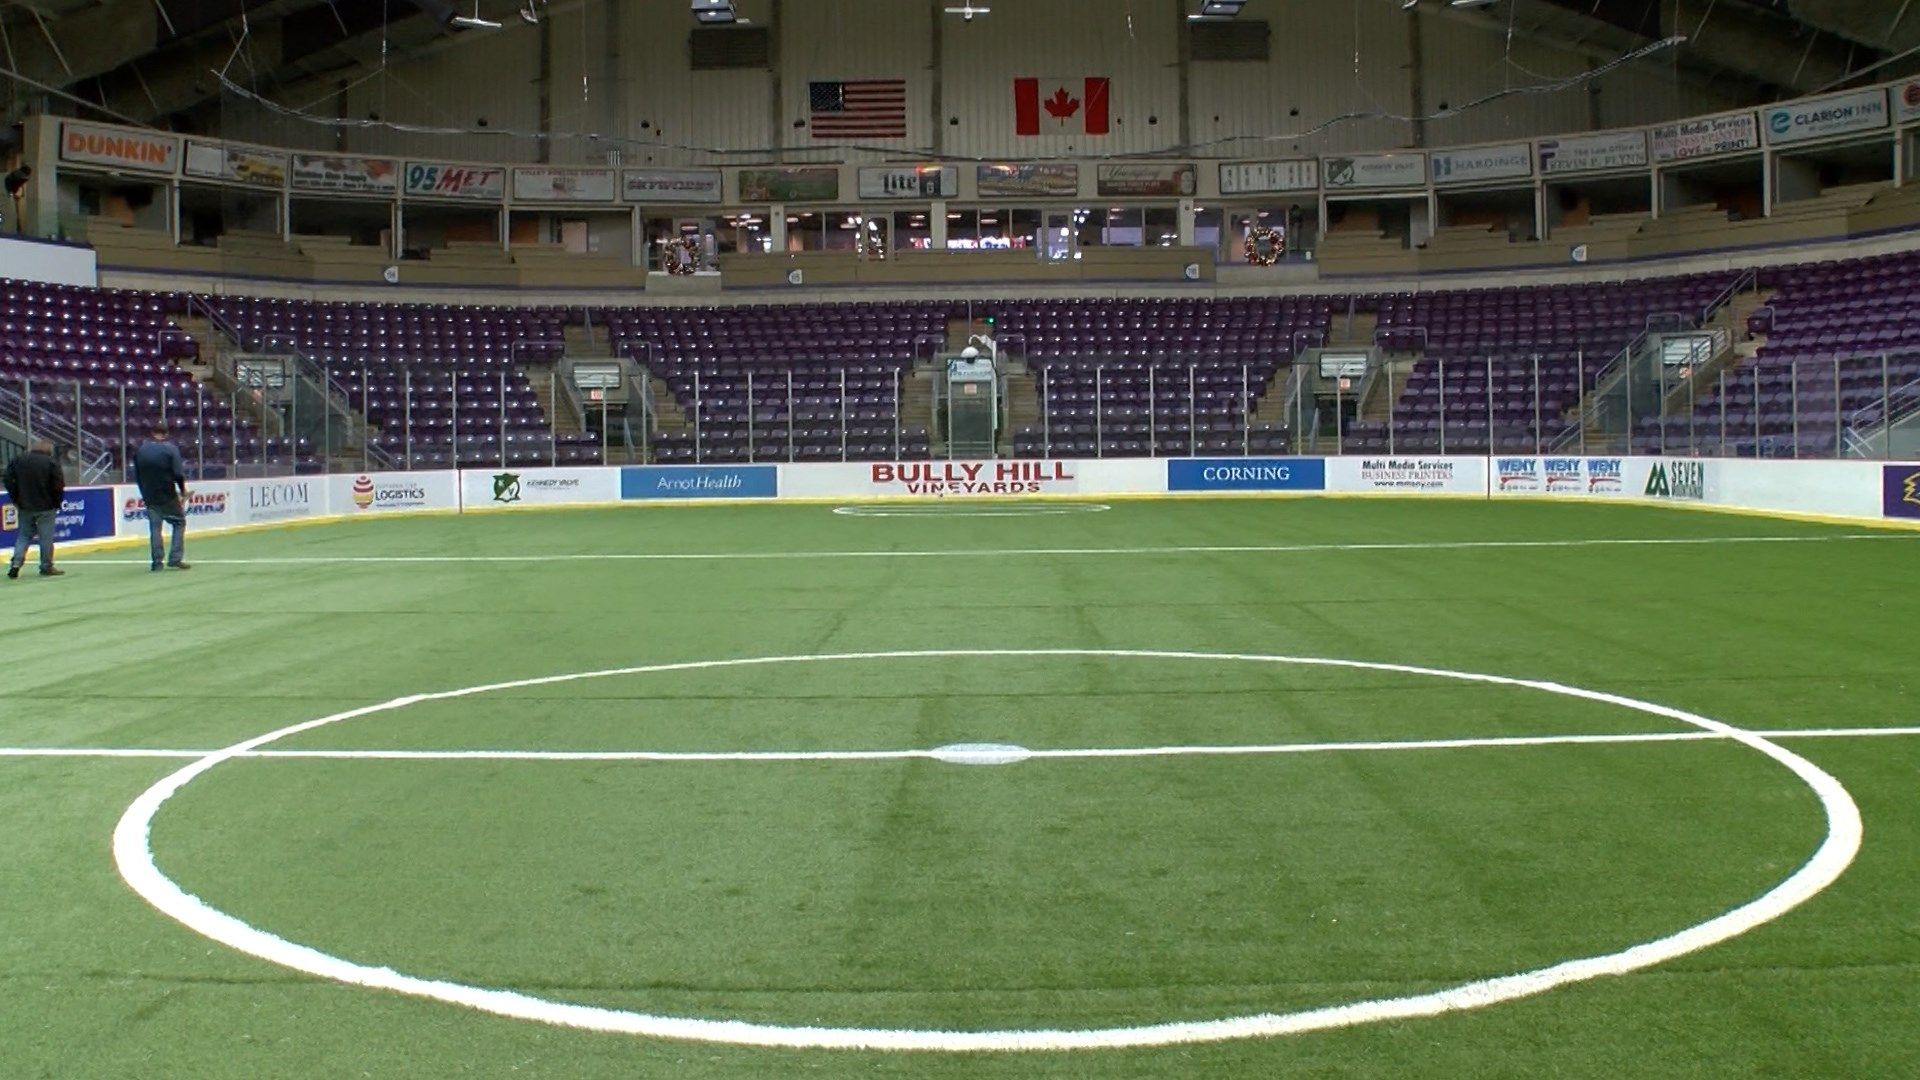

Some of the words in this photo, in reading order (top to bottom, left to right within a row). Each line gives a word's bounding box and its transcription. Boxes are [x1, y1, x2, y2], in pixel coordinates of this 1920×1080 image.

[1795, 107, 1852, 125] CLARION
[1856, 101, 1881, 115] INN
[1680, 124, 1709, 136] Media
[68, 132, 172, 164] DUNKIN'
[409, 165, 439, 191] 95
[435, 166, 500, 193] MET
[872, 464, 984, 482] BULLY
[996, 462, 1074, 481] HILL
[1362, 460, 1386, 470] Multi
[1388, 460, 1416, 470] Media
[1418, 460, 1454, 470] Services
[1671, 461, 1704, 485] SEVEN
[1203, 467, 1291, 481] CORNING
[1361, 470, 1407, 480] BUSINESS
[1408, 470, 1454, 480] PRINTERS
[249, 482, 309, 508] LECOM
[375, 488, 425, 501] LOGISTICS
[908, 481, 1041, 494] VINEYARDS
